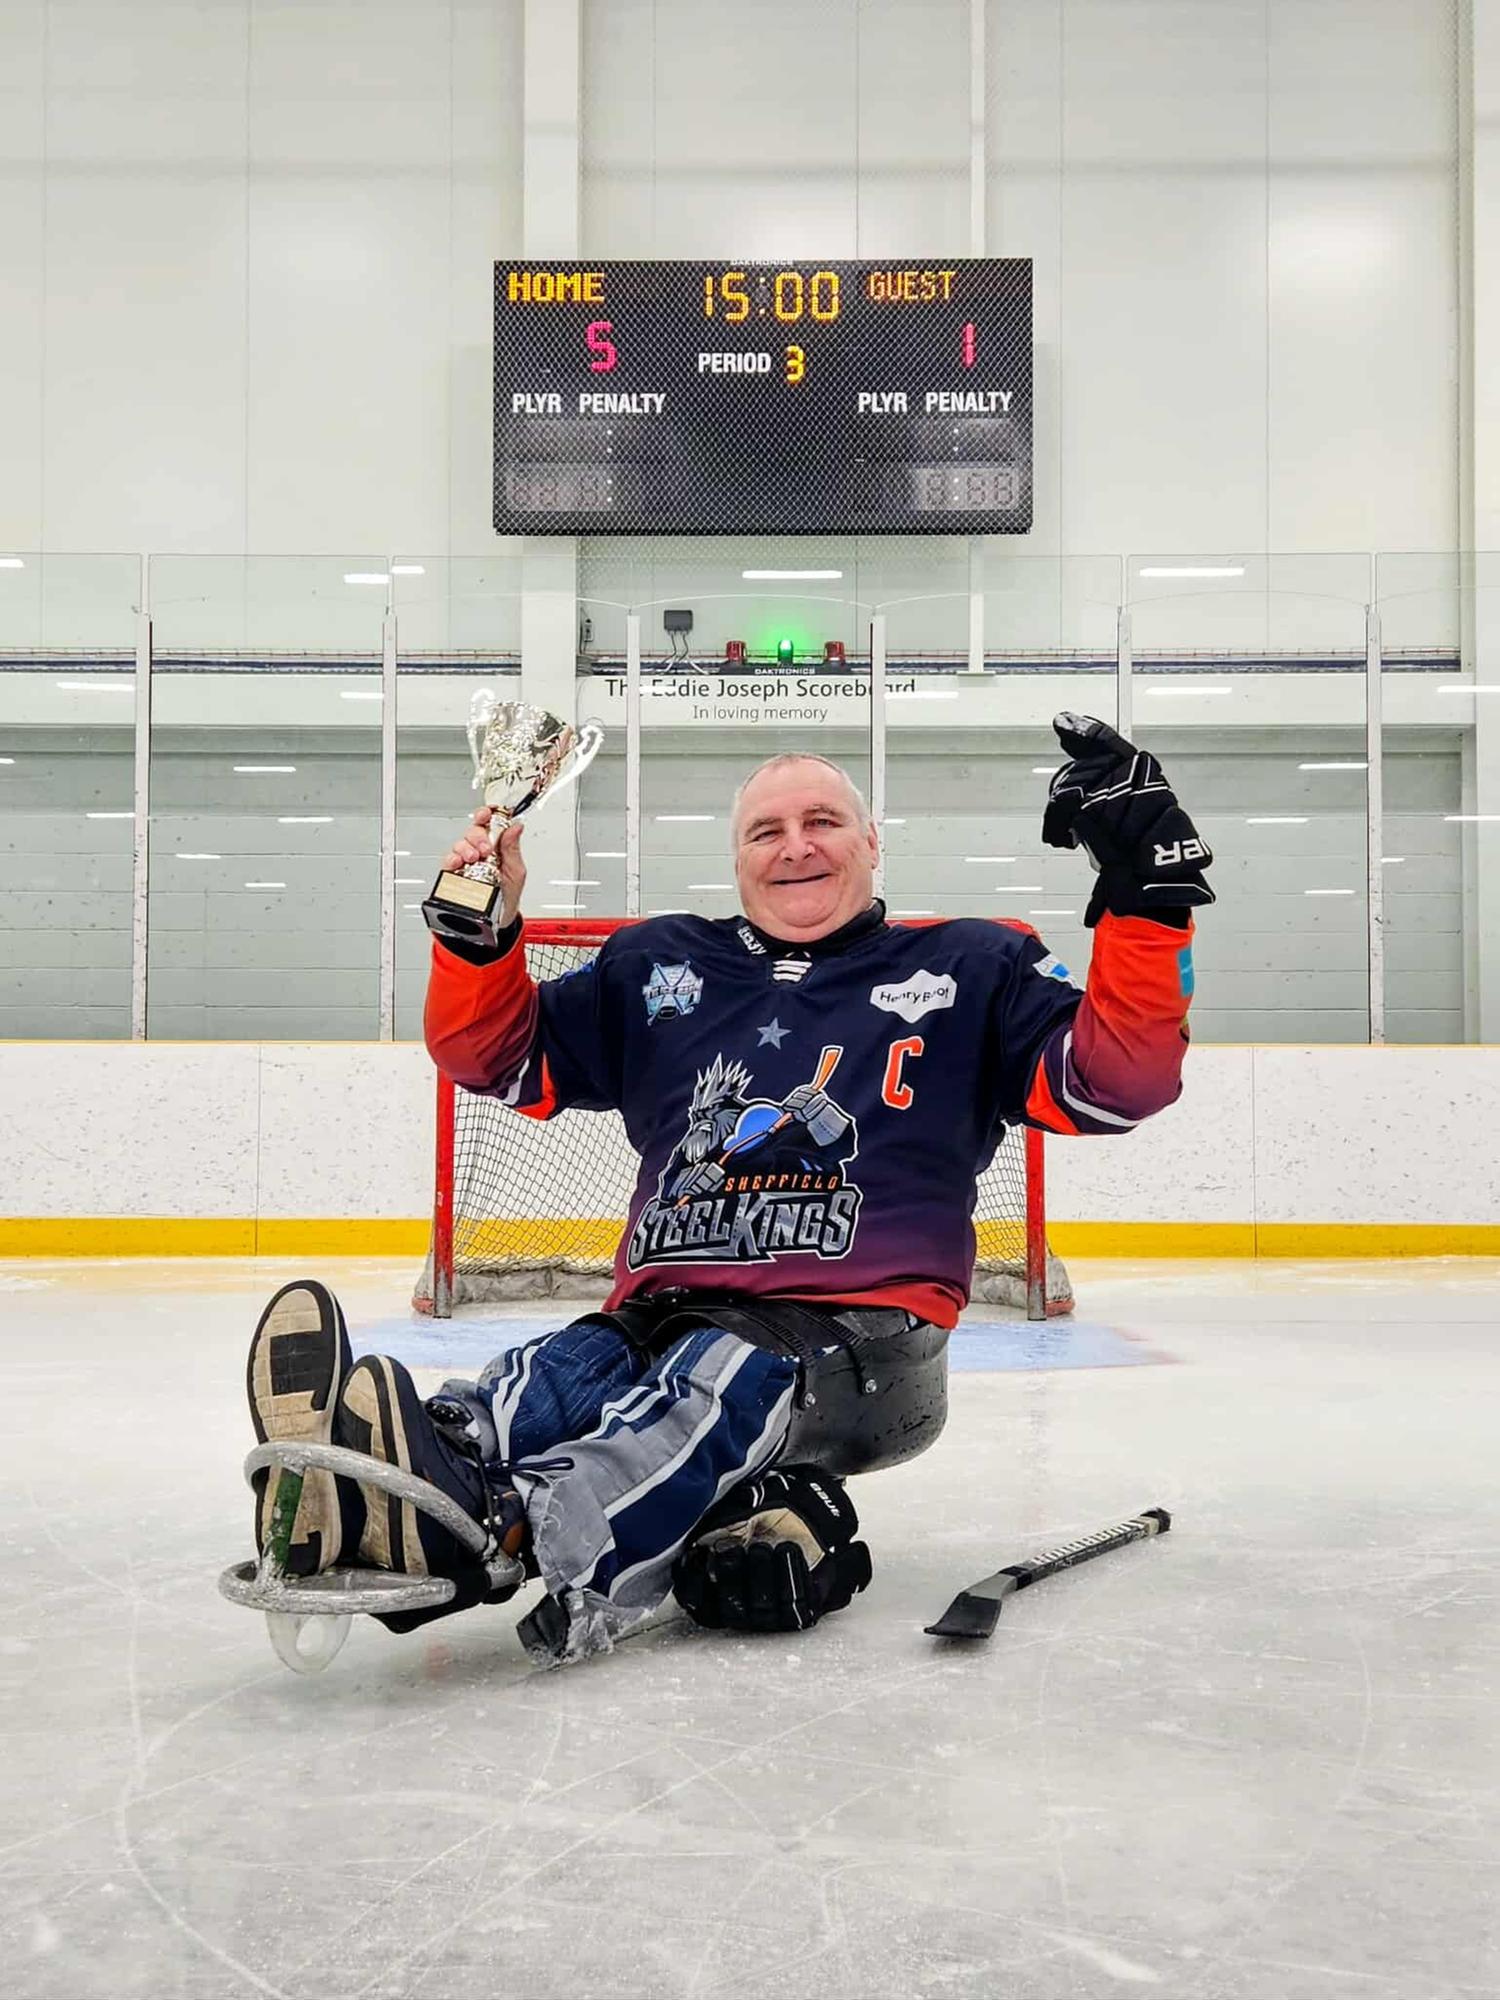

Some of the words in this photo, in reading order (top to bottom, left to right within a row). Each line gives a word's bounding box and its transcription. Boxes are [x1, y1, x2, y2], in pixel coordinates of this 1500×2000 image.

[507, 272, 605, 302] HOME
[704, 271, 841, 322] 15:00
[867, 270, 956, 301] GUEST
[961, 321, 977, 369] 1
[698, 353, 771, 373] PERIOD
[785, 345, 805, 384] 3
[512, 393, 562, 414] PLYR
[579, 393, 667, 414] PENALTY
[857, 392, 908, 413] PLYR
[925, 391, 1013, 412] PENALTY
[605, 679, 643, 697] Th
[717, 679, 789, 702] Joseph
[693, 705, 709, 719] In
[713, 705, 759, 723] loving
[764, 708, 828, 723] memory
[881, 1036, 925, 1110] C
[725, 1173, 839, 1192] SHEFFIELD
